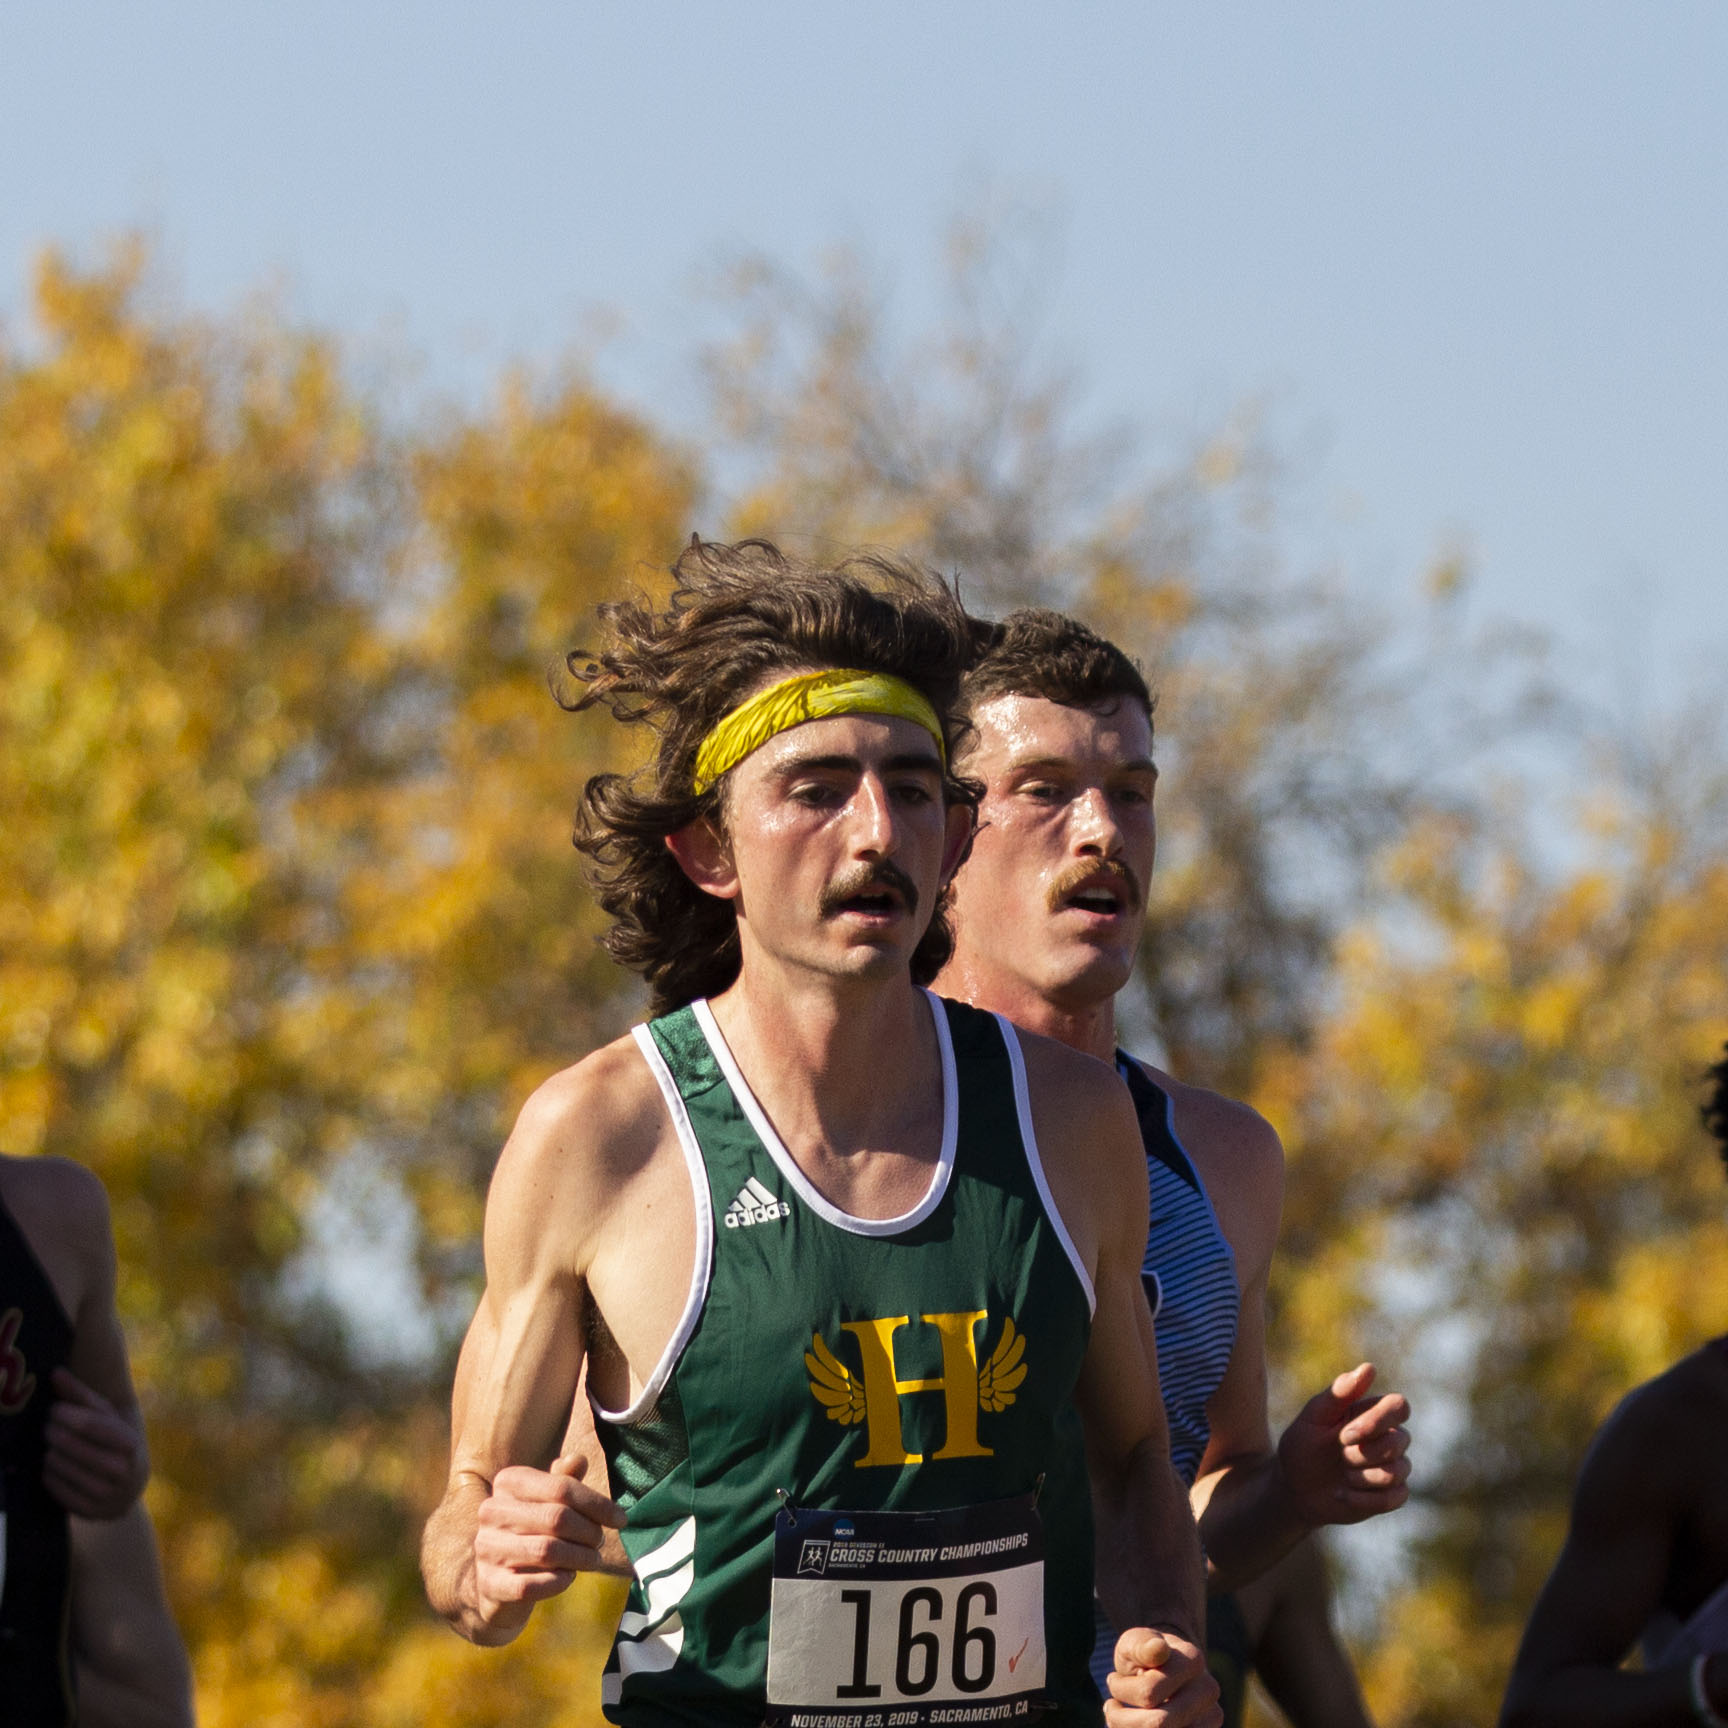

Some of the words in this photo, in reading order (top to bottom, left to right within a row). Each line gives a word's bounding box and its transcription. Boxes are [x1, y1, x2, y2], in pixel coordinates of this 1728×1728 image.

[724, 1201, 790, 1228] adidas
[840, 1309, 994, 1468] H
[830, 1548, 874, 1562] CROSS
[878, 1547, 937, 1563] COUNTRY
[940, 1533, 1029, 1561] CHAMPIONSHIPS
[837, 1581, 997, 1698] 166
[791, 1713, 861, 1728] NOVEMBER
[864, 1713, 884, 1728] 23,
[888, 1711, 918, 1726] 2019
[929, 1703, 1012, 1723] SACRAMENTO,
[1015, 1700, 1029, 1715] CA
